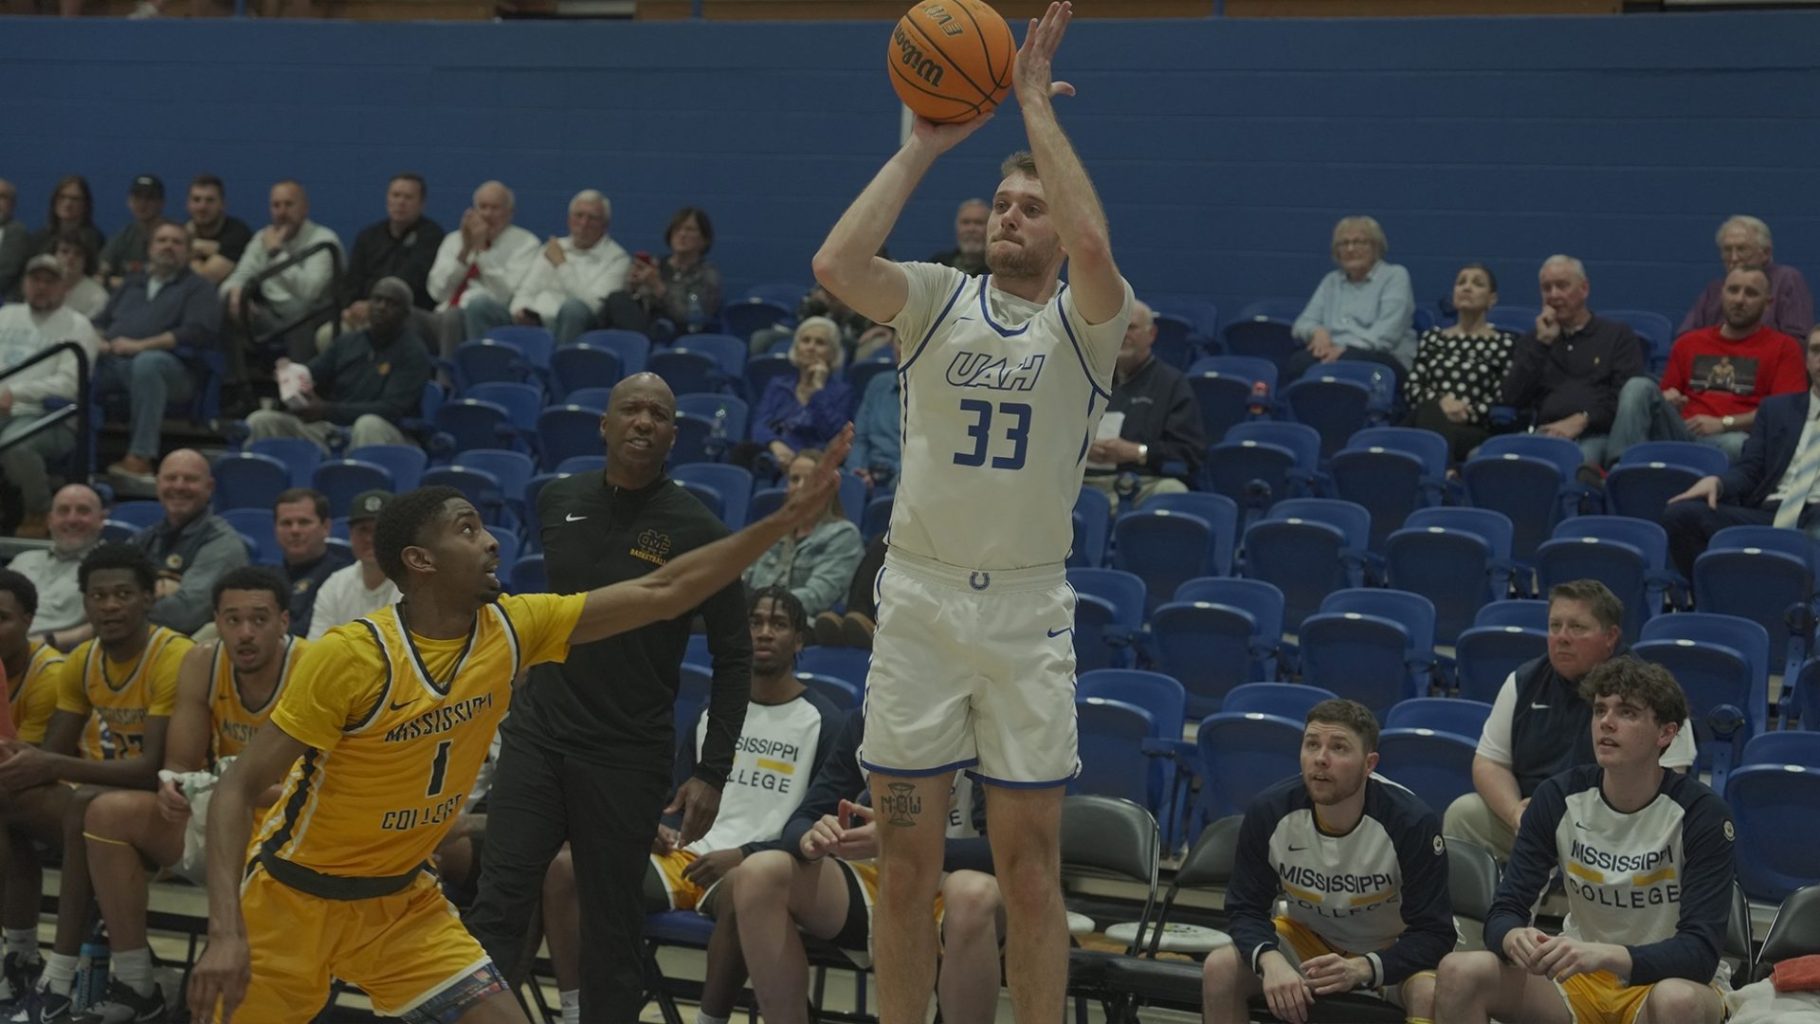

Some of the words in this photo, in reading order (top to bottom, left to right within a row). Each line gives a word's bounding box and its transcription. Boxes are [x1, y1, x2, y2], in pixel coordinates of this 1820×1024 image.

[945, 350, 1046, 392] UAH
[952, 398, 1033, 471] 33
[734, 736, 799, 763] SISSIPPI
[425, 740, 454, 797] 1
[727, 769, 791, 794] LLEGE
[1570, 839, 1675, 873] MISSISSIPPI
[1279, 862, 1393, 894] MISSISSIPPI
[1568, 878, 1681, 909] COLLEGE
